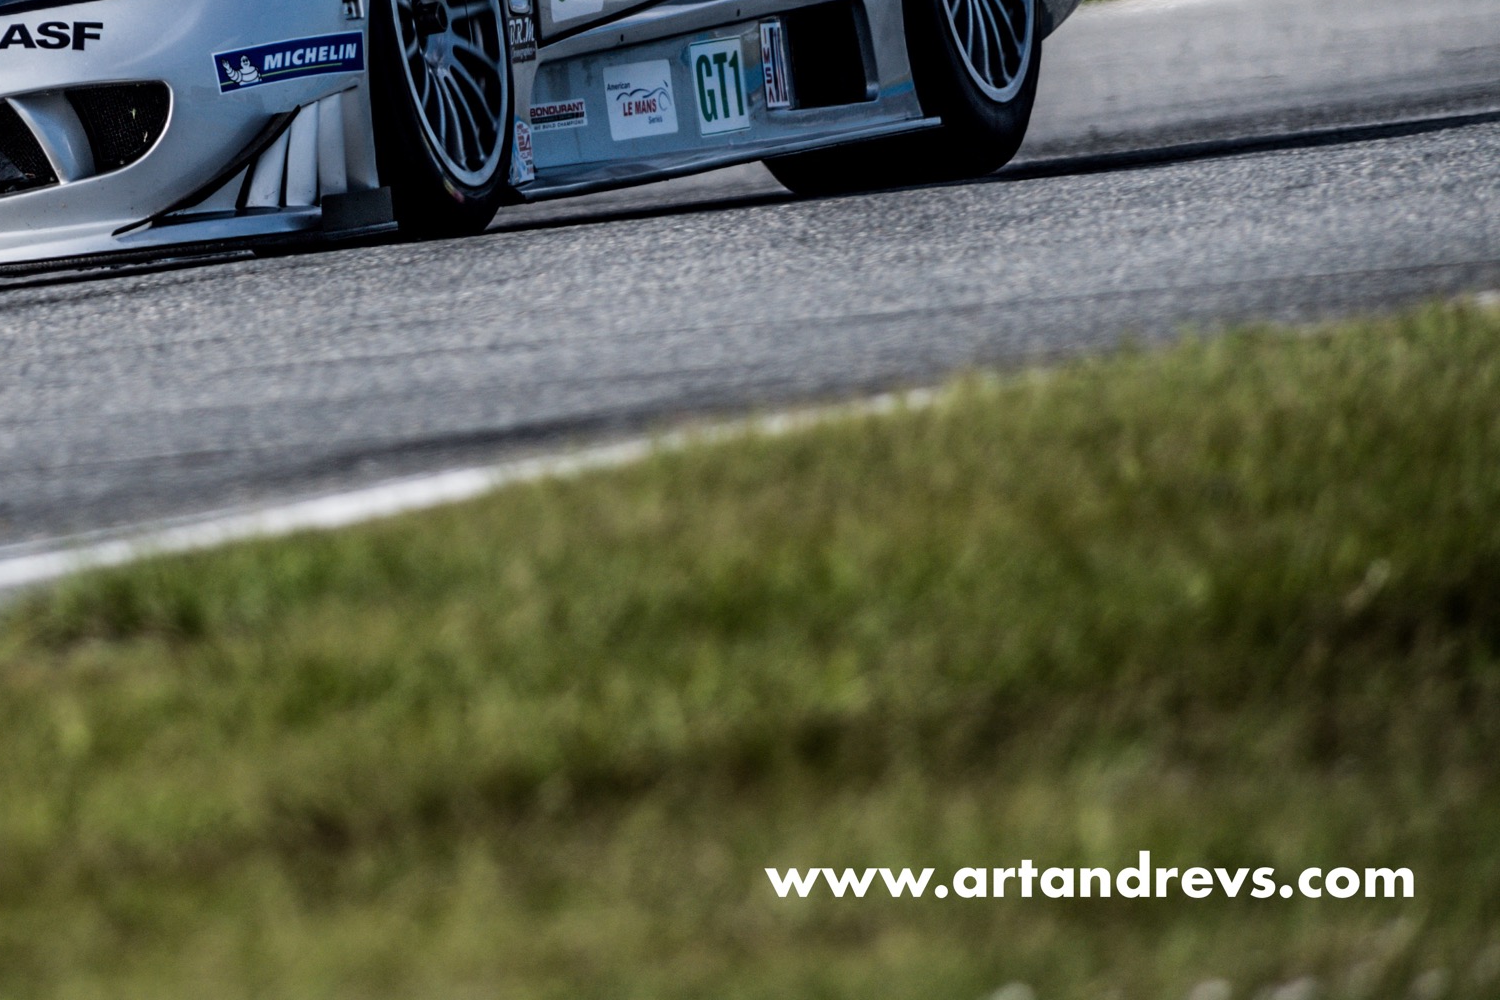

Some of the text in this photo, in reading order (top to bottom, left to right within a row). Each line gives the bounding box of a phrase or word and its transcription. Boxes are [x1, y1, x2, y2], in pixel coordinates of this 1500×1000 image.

[263, 42, 357, 71] MICHELIN
[606, 81, 631, 92] American
[695, 49, 745, 123] GT1
[530, 101, 584, 118] BONDURANT
[622, 98, 657, 117] LE MANS
